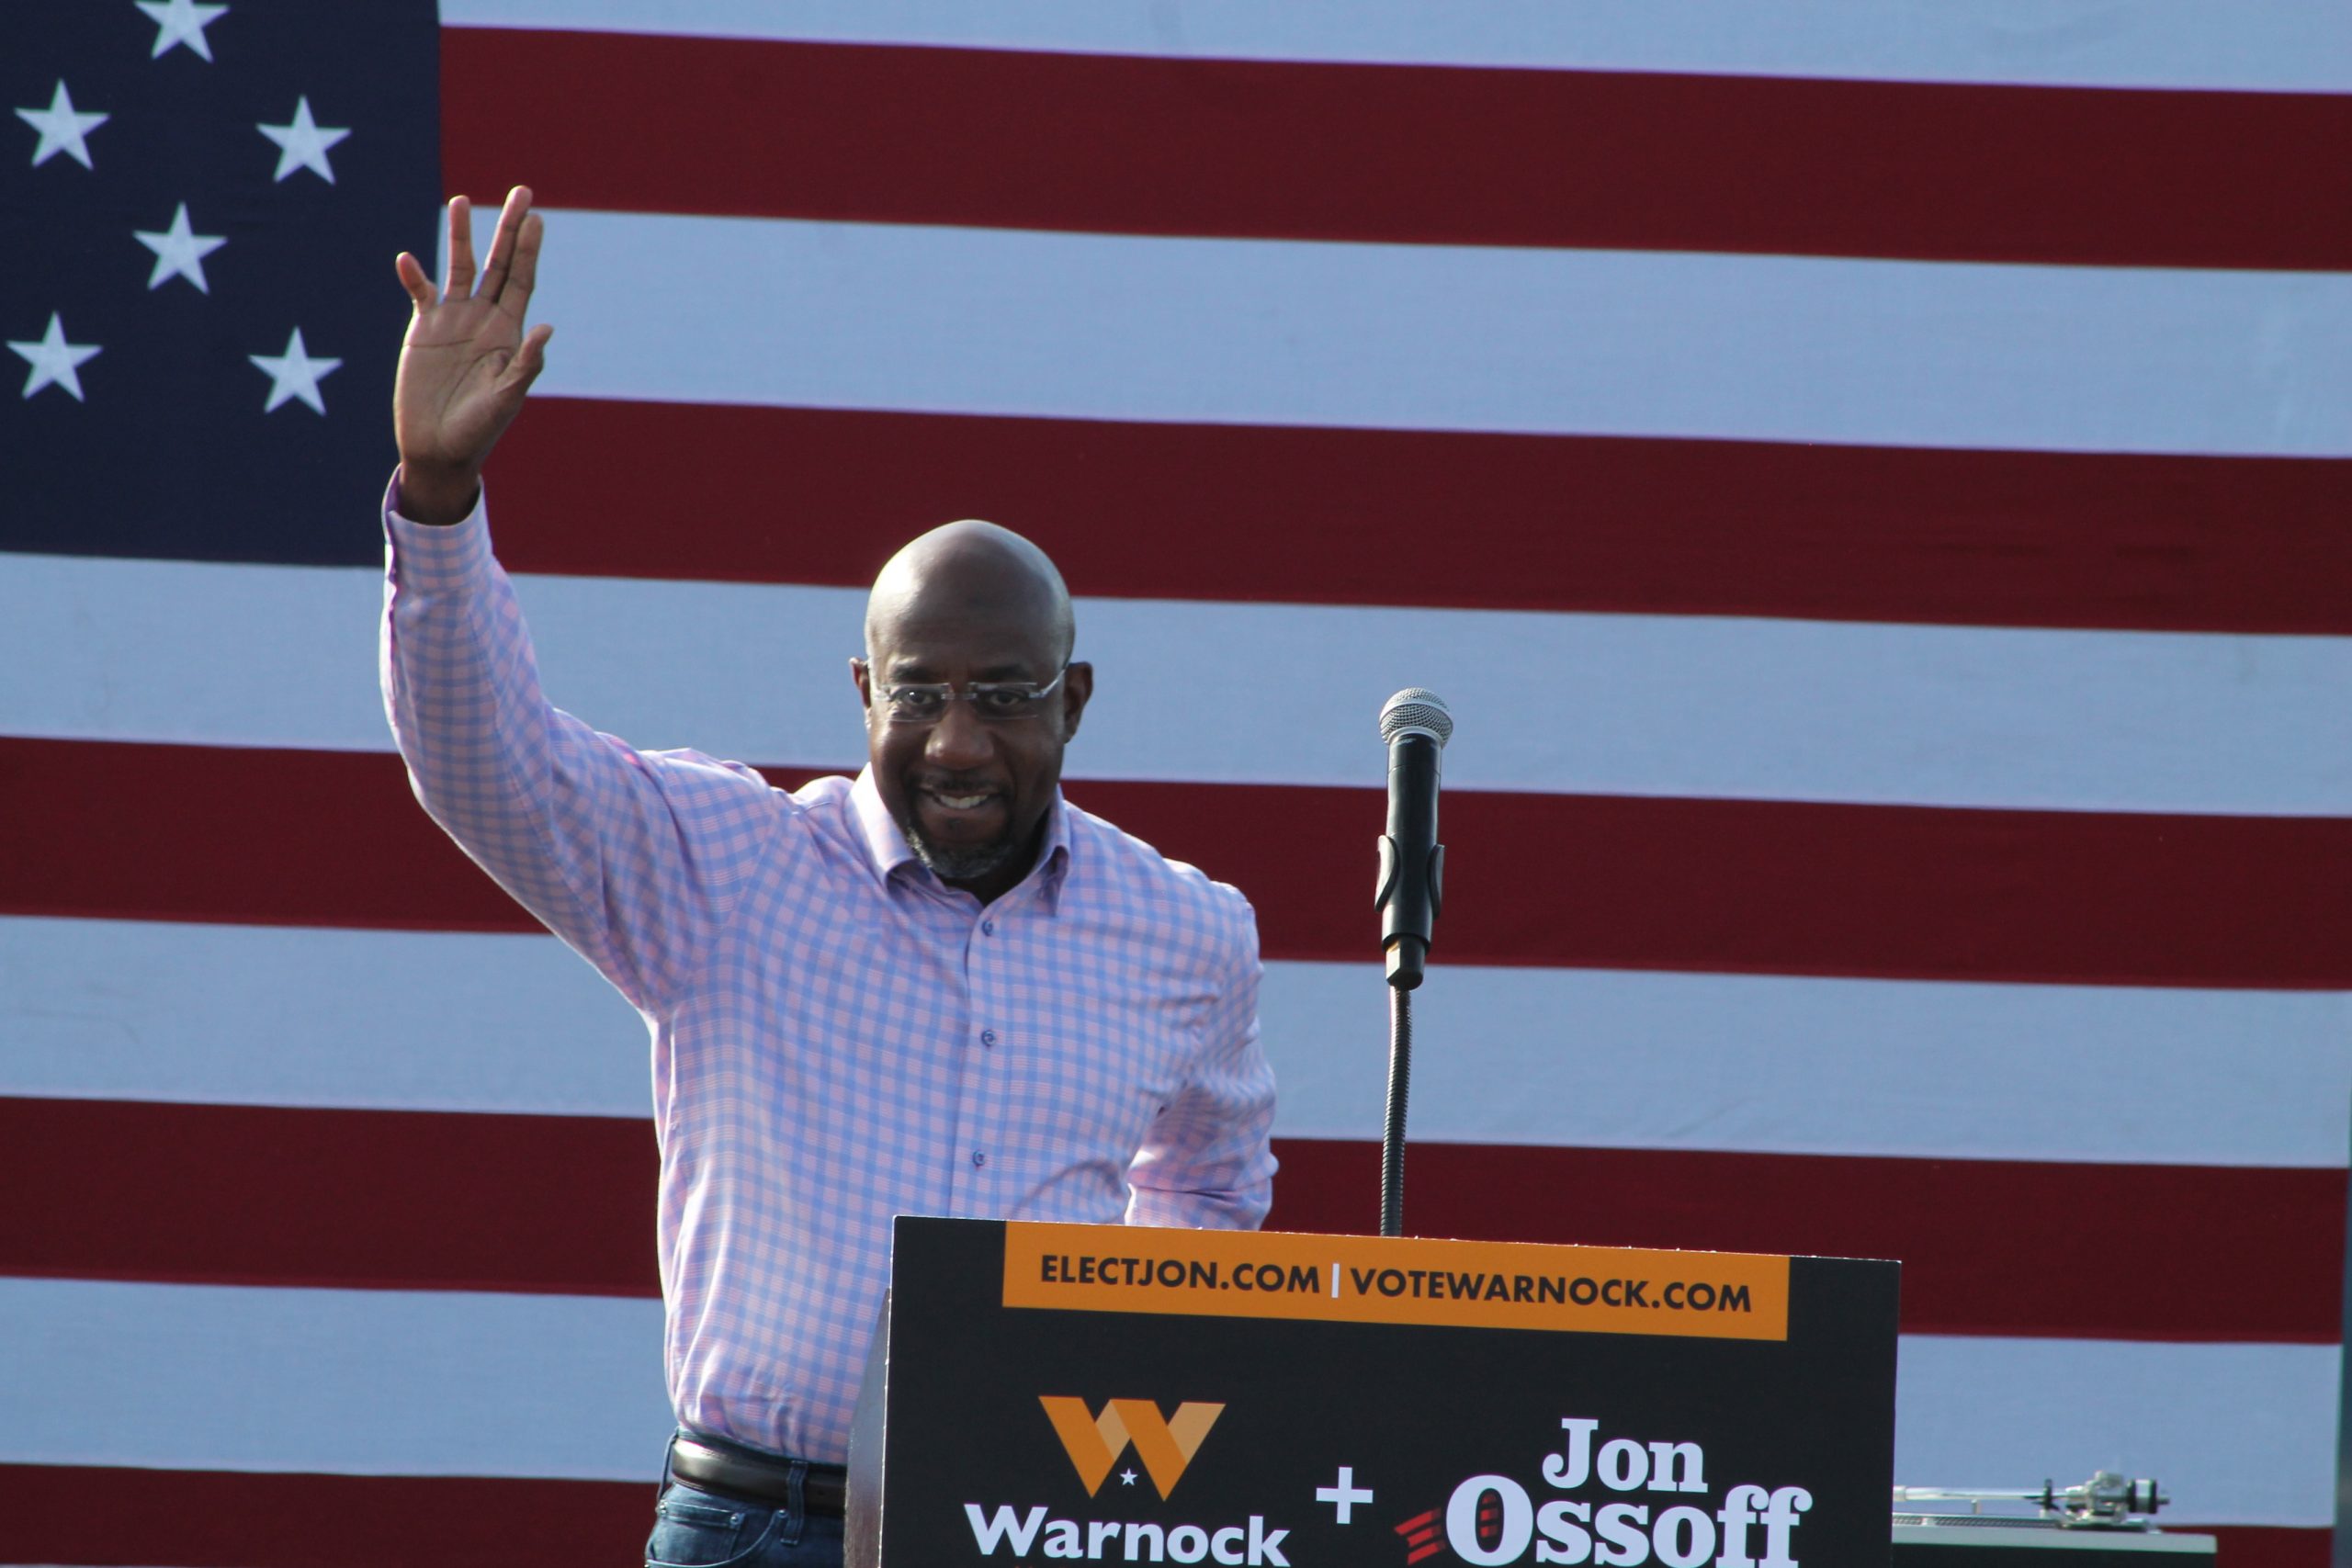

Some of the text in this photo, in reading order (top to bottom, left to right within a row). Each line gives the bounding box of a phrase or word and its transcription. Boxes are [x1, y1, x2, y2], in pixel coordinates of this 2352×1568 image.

[1041, 1254, 1320, 1293] ELECTJON.COM
[1350, 1268, 1751, 1313] VOTEWARNOCK.COM
[1038, 1395, 1226, 1501] W
[1542, 1417, 1709, 1494] Jon
[964, 1503, 1291, 1567] Warnock
[1445, 1473, 1814, 1568] Ossoff
